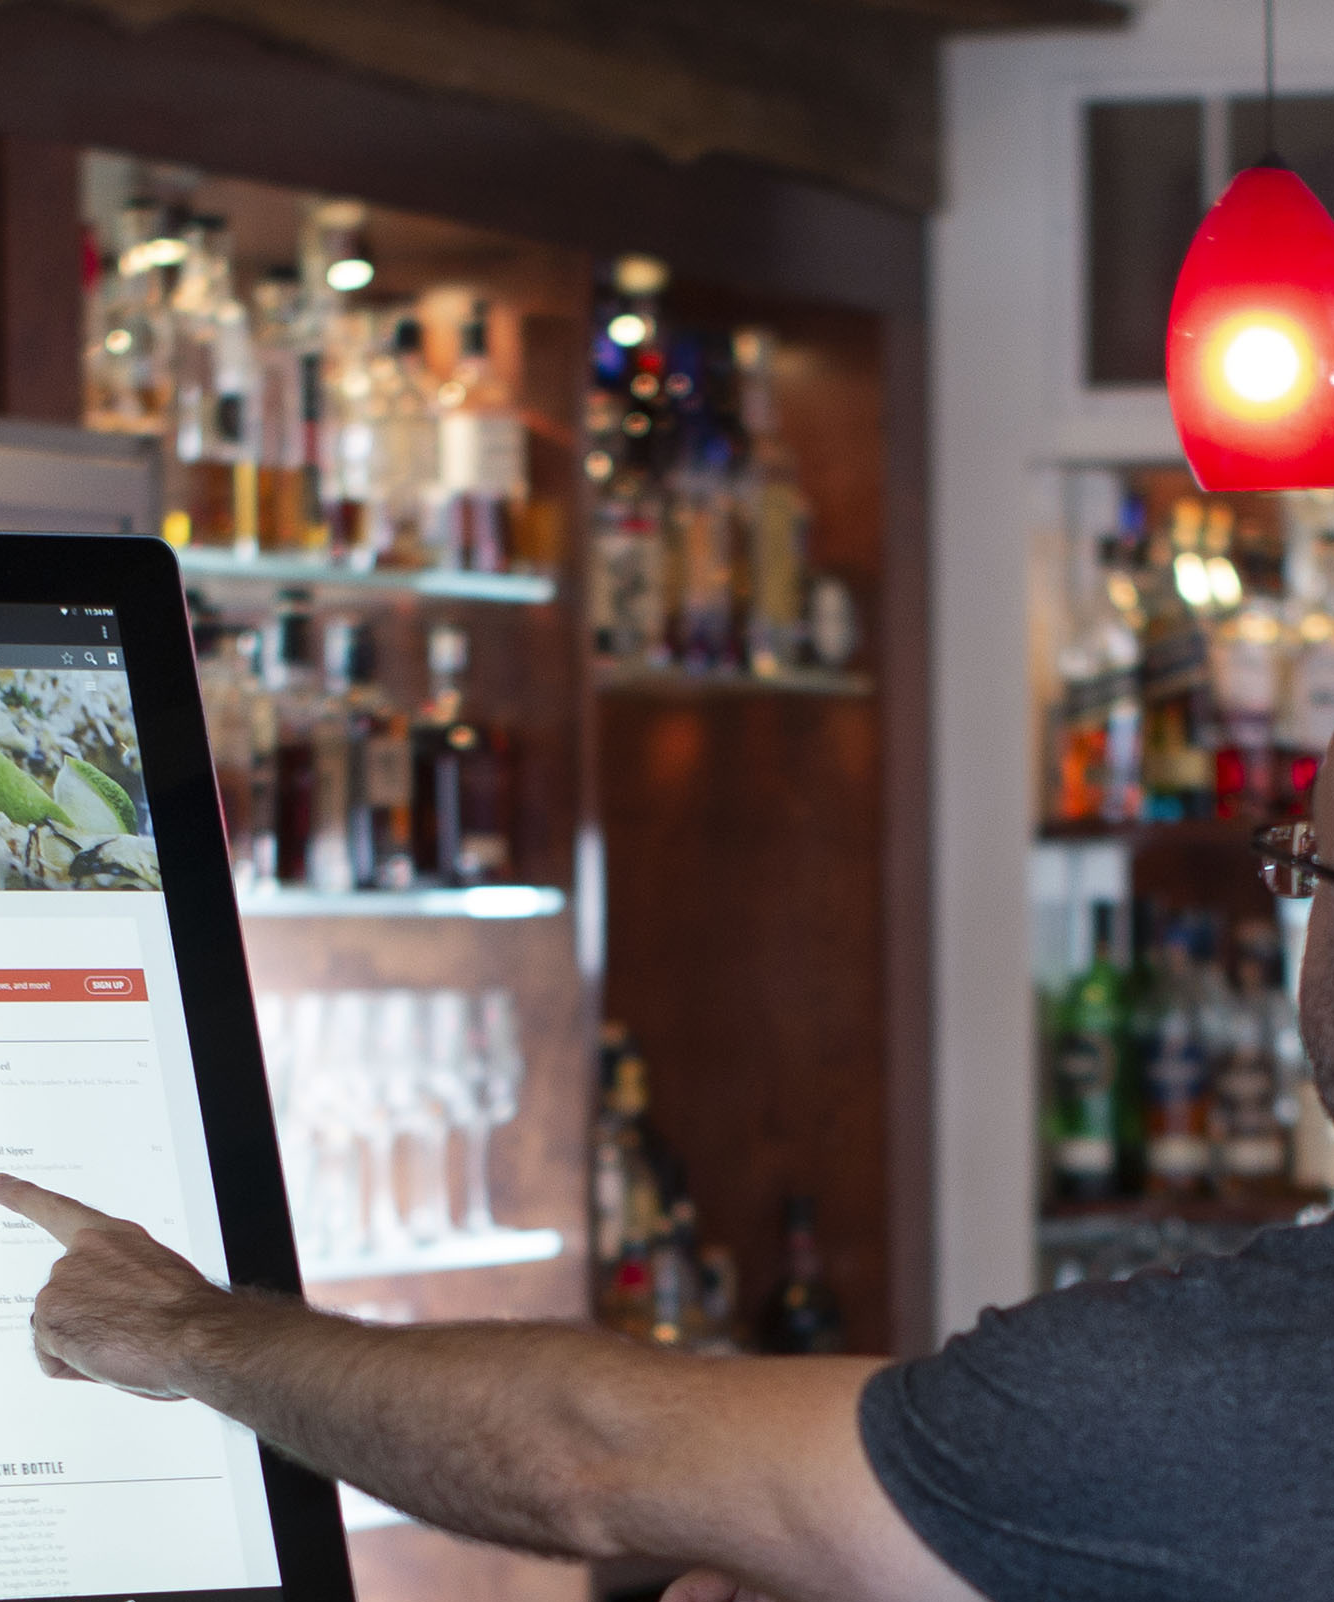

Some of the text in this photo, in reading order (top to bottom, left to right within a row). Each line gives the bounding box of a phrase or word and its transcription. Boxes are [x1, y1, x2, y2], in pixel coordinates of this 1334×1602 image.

[12, 982, 28, 991] and
[28, 981, 51, 991] more!
[92, 981, 125, 990] SIGN UP
[5, 1147, 35, 1158] Sipper
[22, 1461, 65, 1475] BOTTLE
